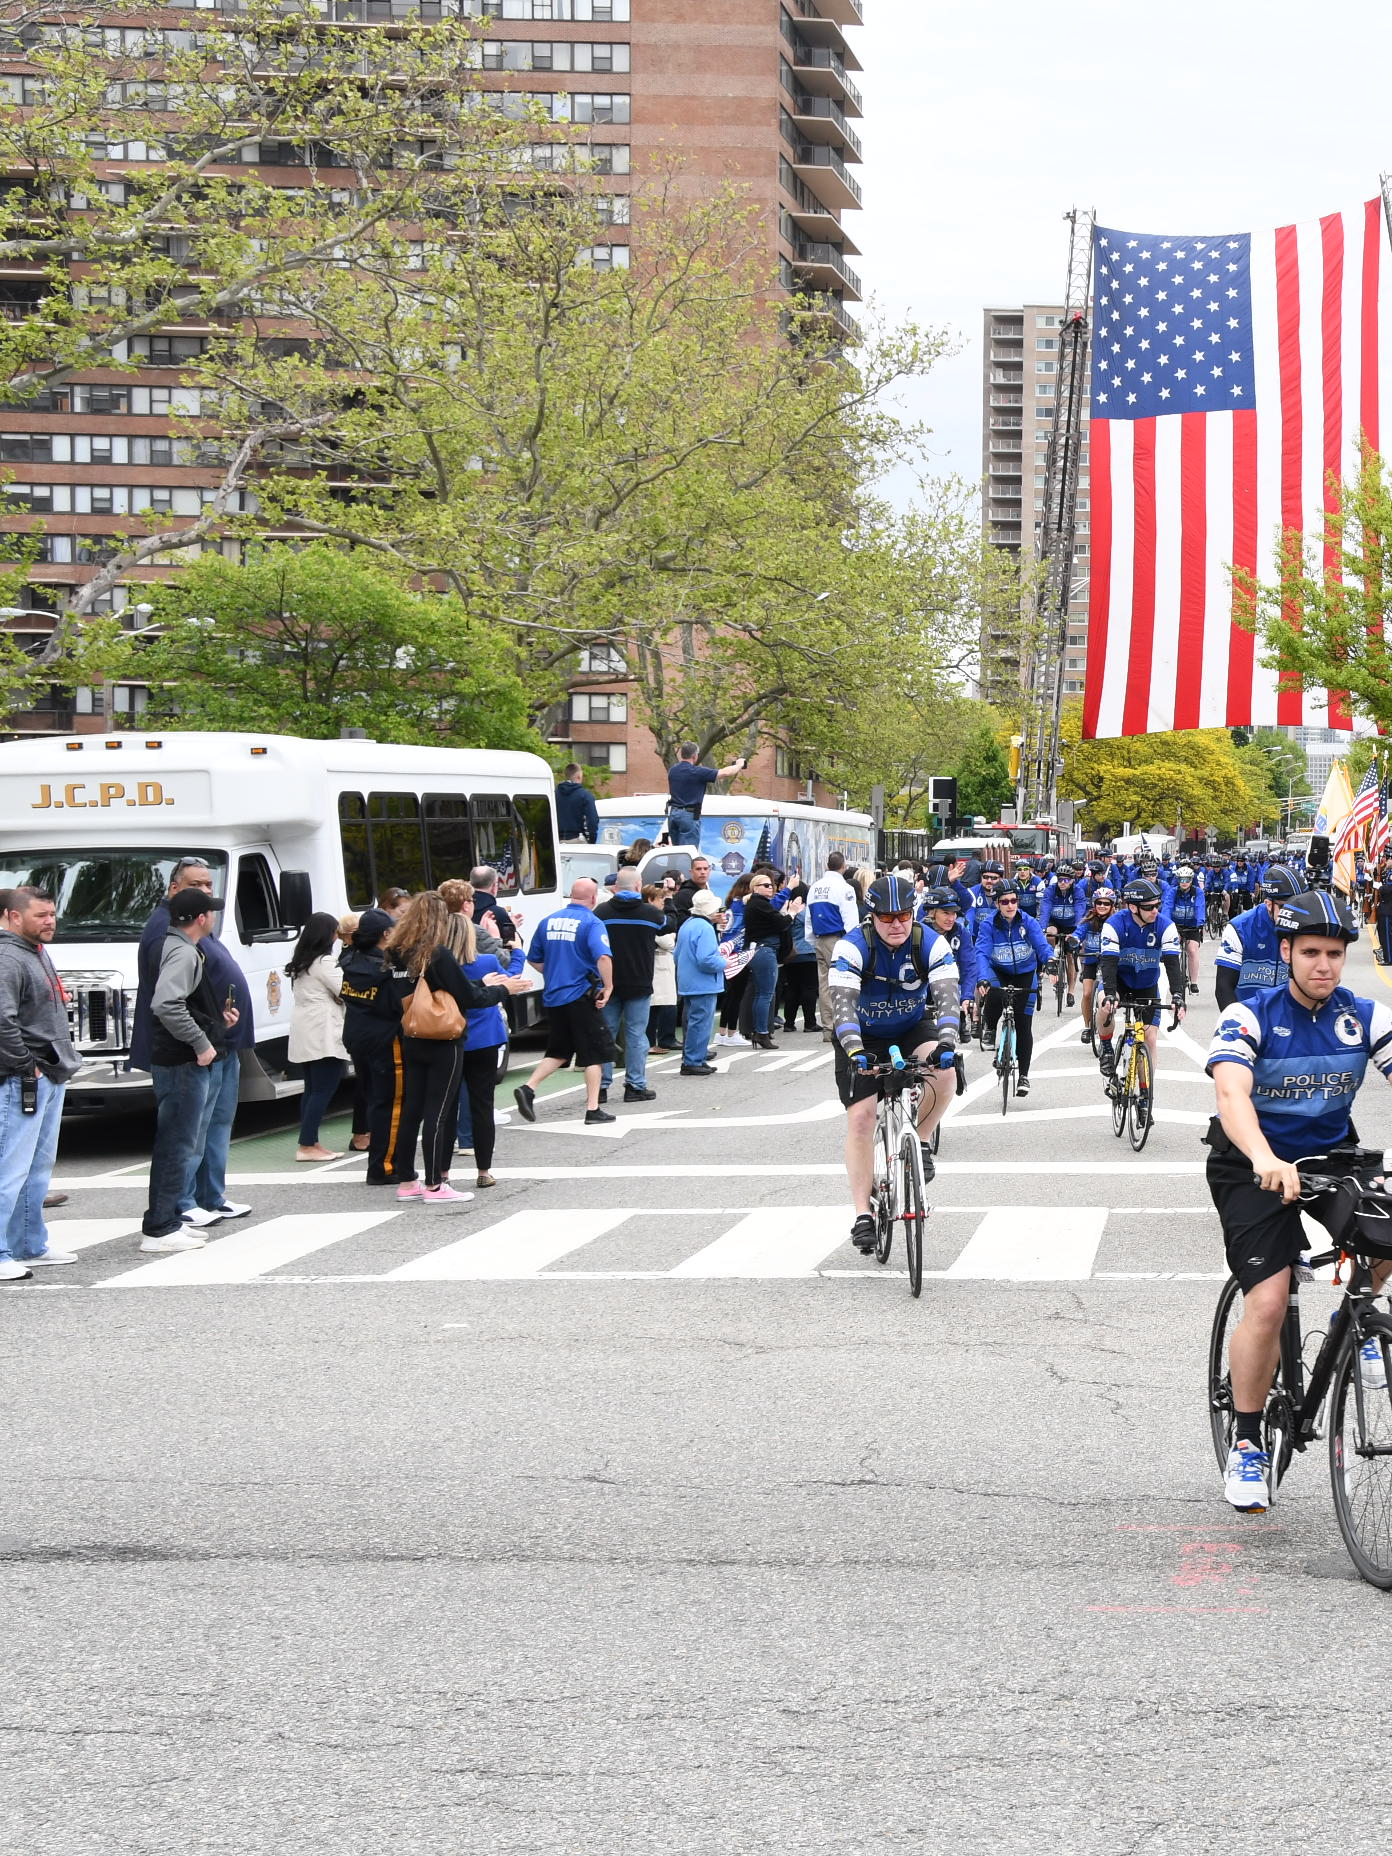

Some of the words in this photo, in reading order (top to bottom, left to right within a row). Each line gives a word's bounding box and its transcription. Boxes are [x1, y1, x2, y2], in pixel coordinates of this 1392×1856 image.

[31, 781, 175, 809] J.C.P.D.
[1279, 917, 1300, 930] TOUR
[869, 998, 917, 1010] POLICE
[1283, 1071, 1353, 1088] POLICE
[1256, 1085, 1317, 1100] UNITY
